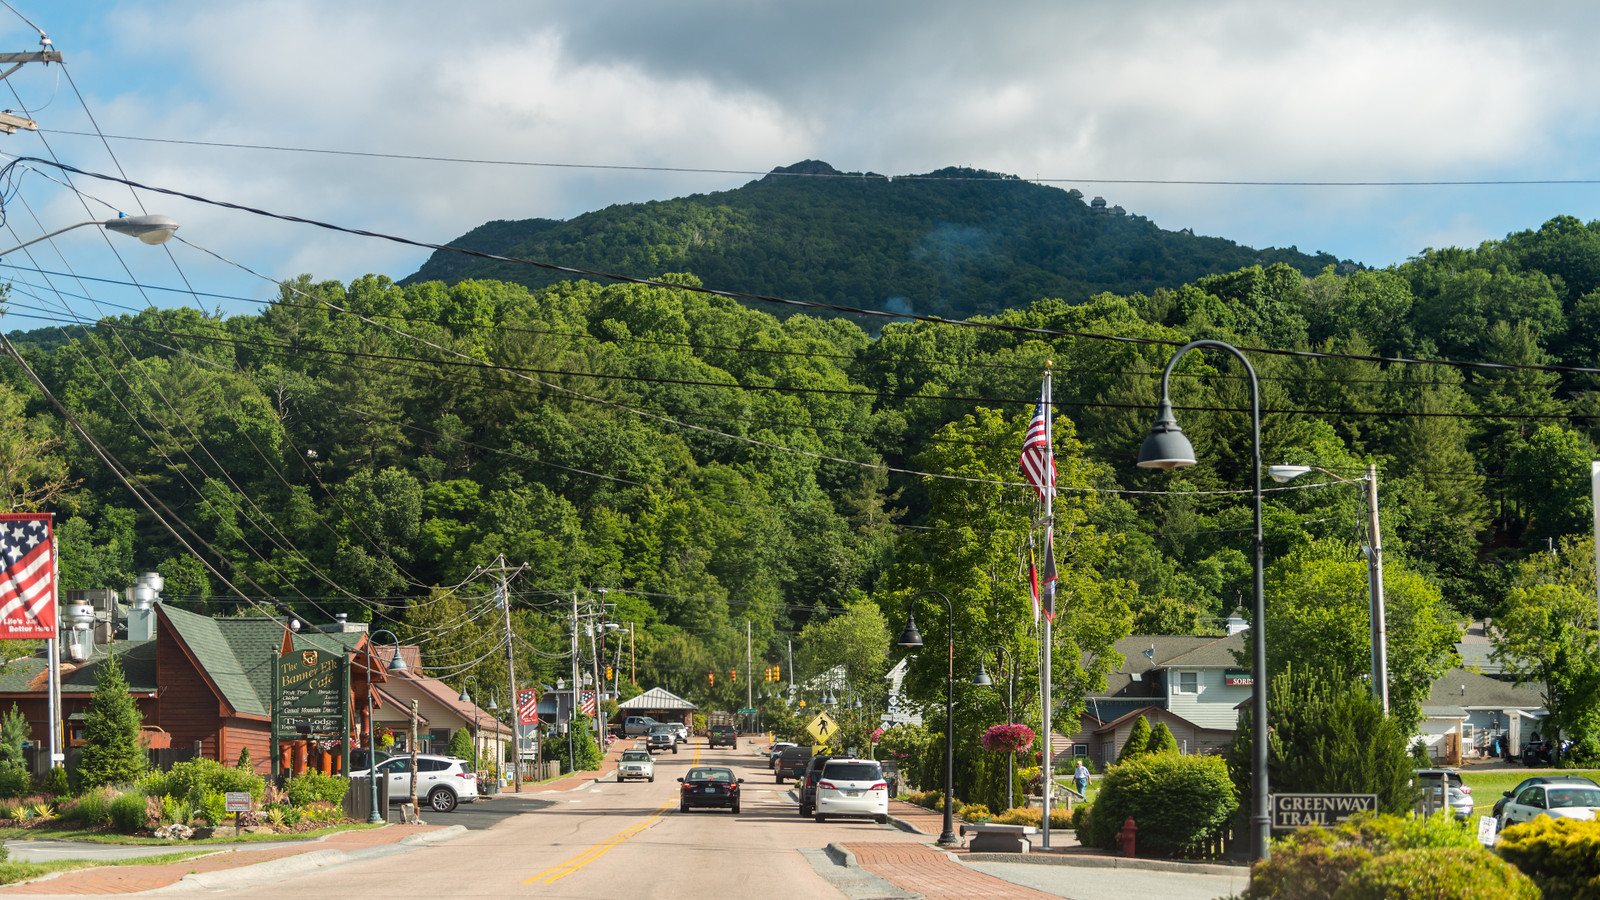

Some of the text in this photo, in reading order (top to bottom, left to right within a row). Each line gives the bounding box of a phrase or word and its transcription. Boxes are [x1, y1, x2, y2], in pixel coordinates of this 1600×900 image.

[281, 662, 298, 673] The
[282, 659, 337, 688] Banner Elk
[309, 672, 334, 689] Café
[1279, 797, 1371, 811] GREENWAY
[1279, 812, 1329, 825] TRAIL
